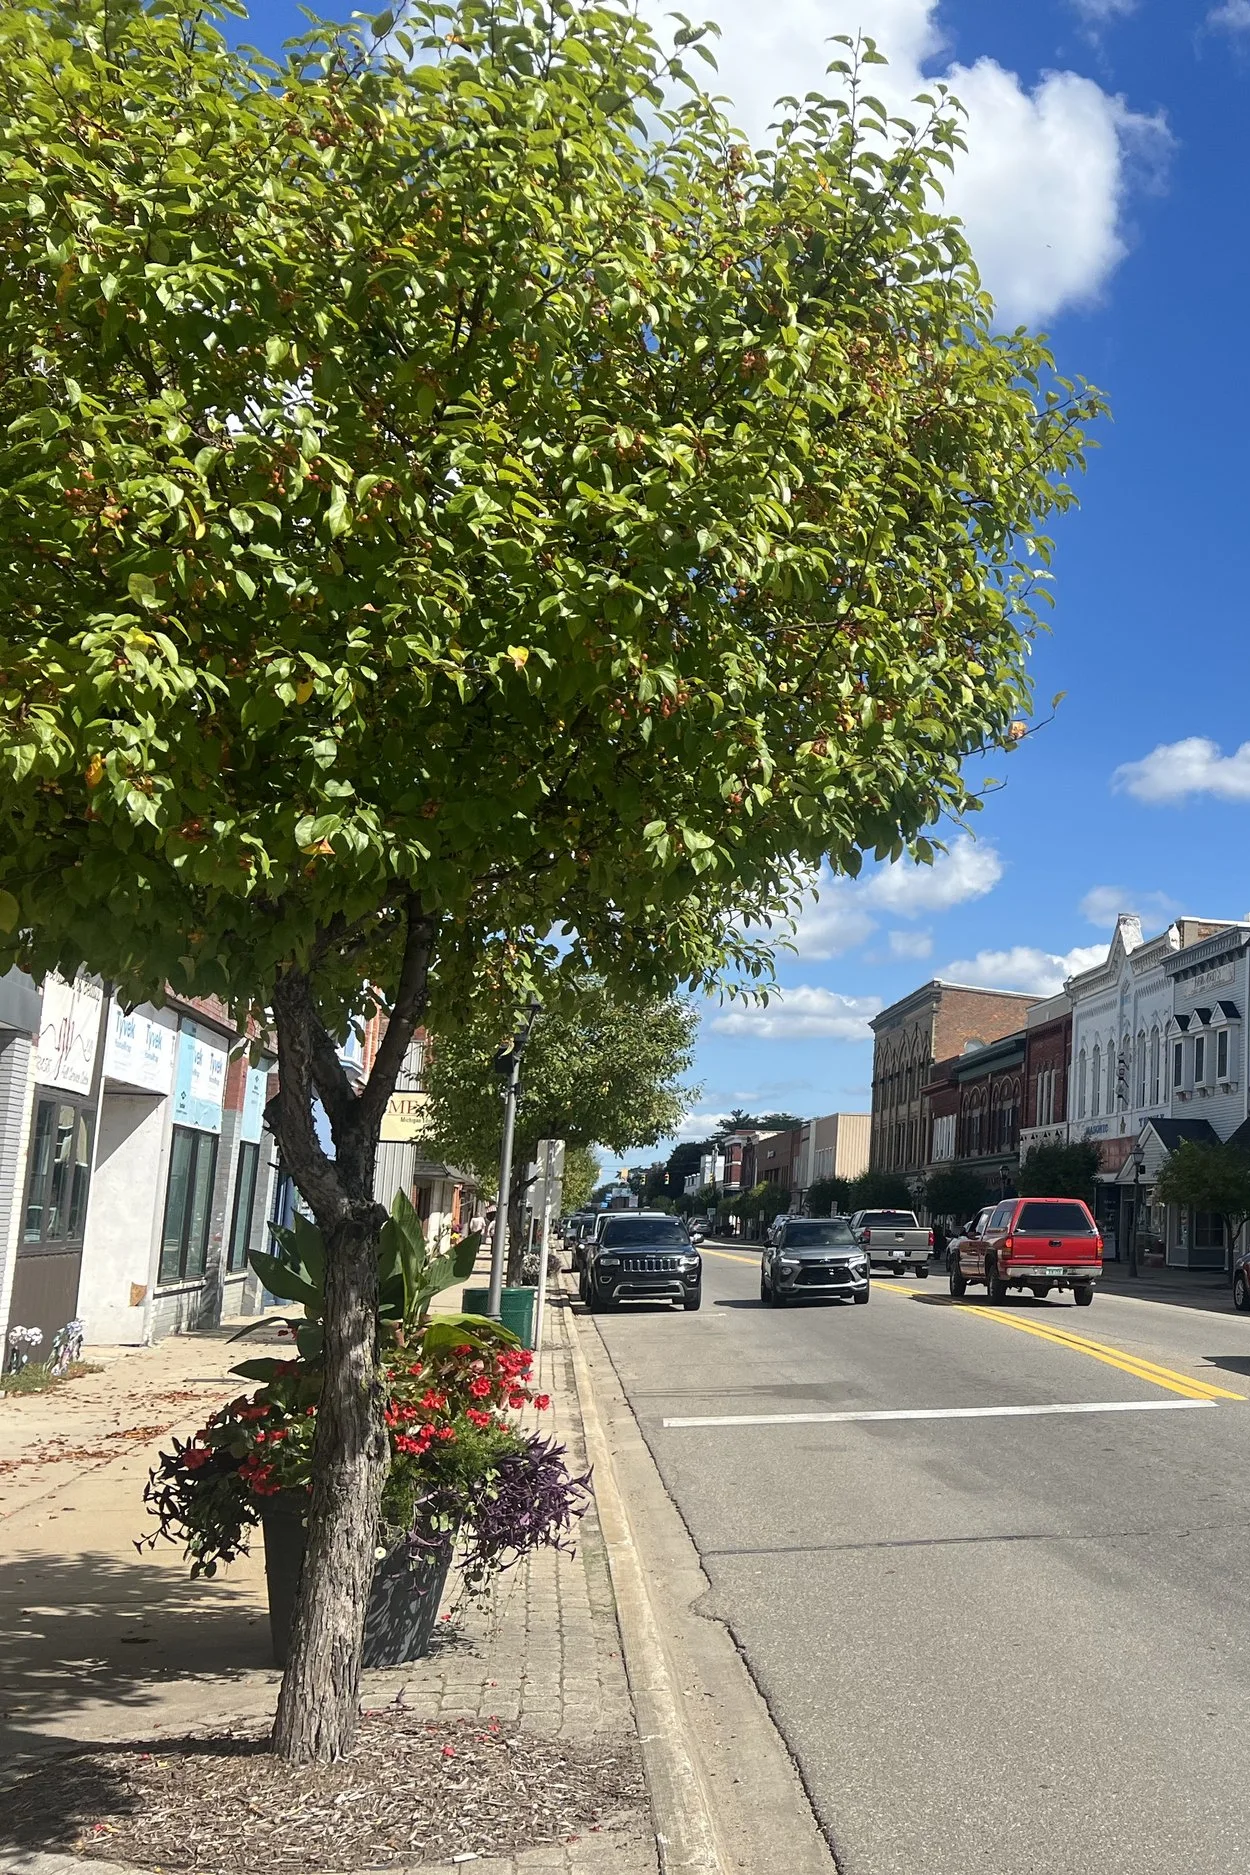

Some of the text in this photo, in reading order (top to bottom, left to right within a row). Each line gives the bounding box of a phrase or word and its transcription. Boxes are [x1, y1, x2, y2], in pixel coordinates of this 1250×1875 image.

[115, 1010, 136, 1039] Tyvek
[145, 1023, 163, 1050] Tyvek
[209, 1052, 224, 1076] Tyvek
[400, 1116, 421, 1124] Michigan
[1085, 1123, 1109, 1136] MASONIC
